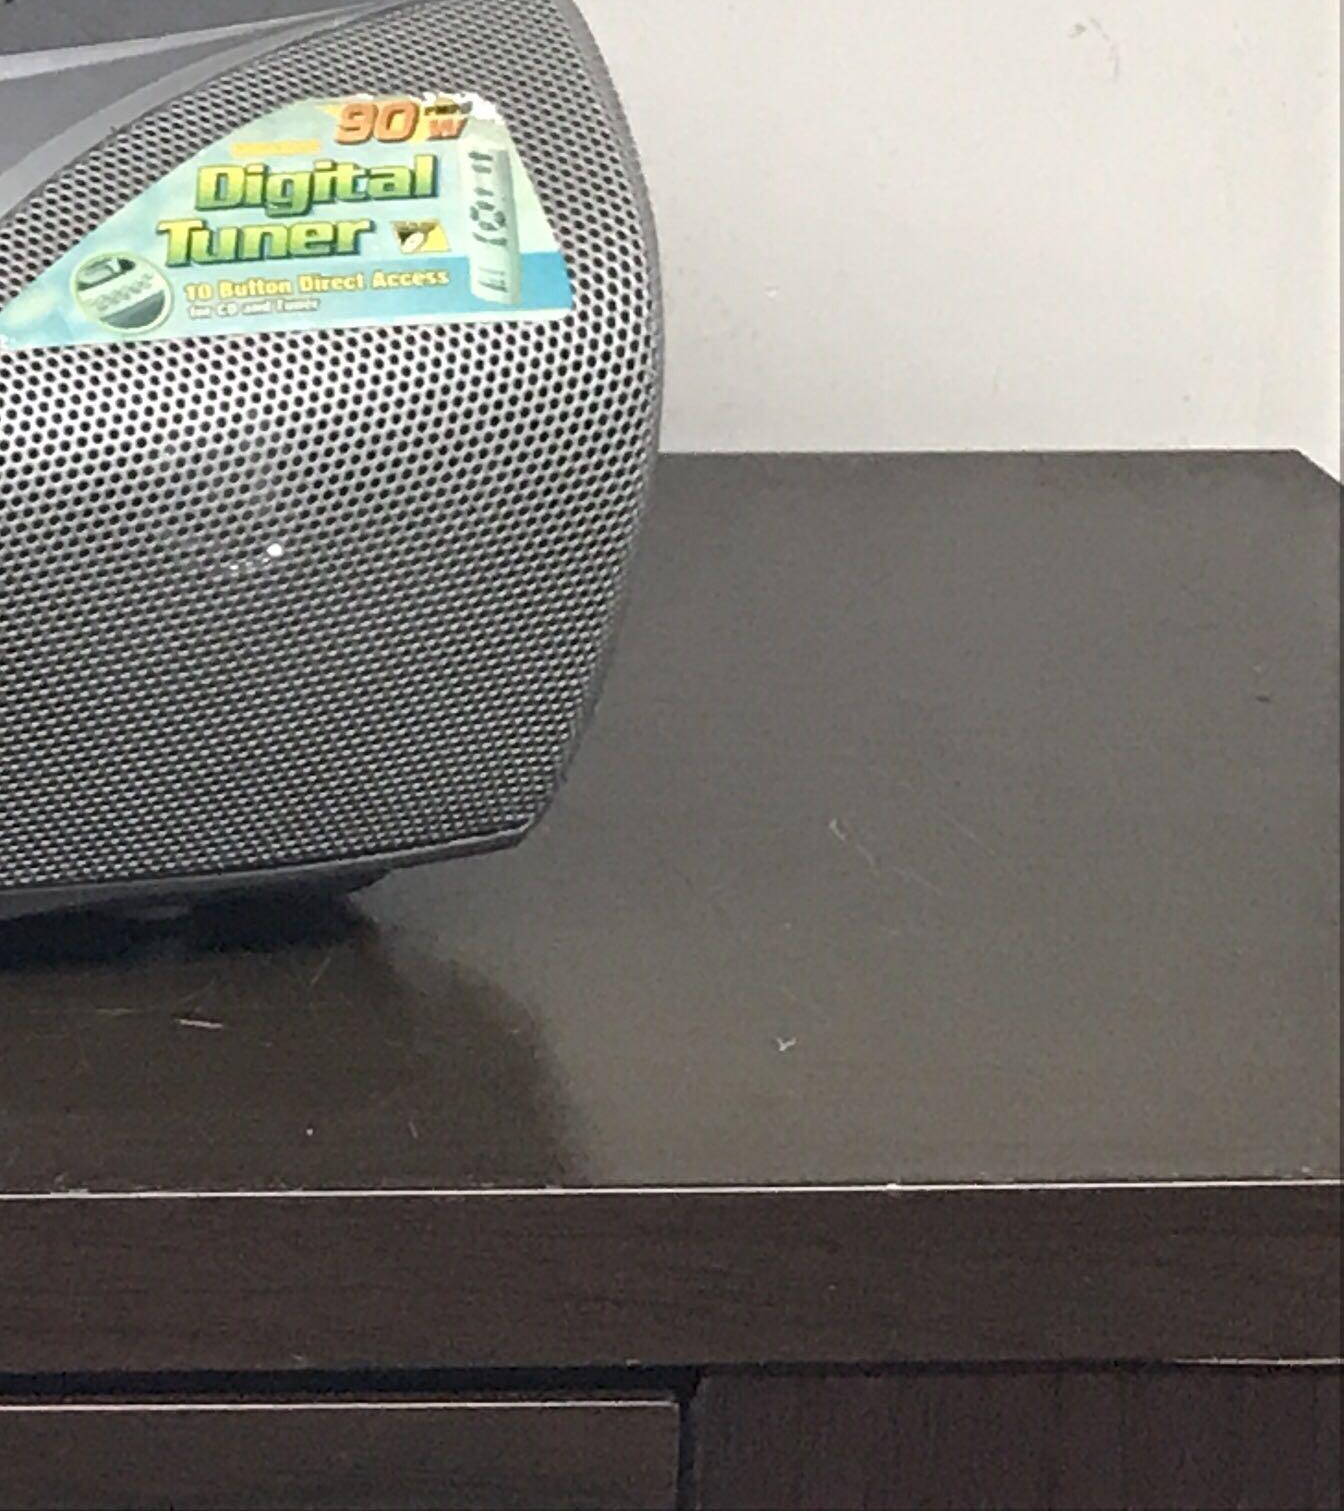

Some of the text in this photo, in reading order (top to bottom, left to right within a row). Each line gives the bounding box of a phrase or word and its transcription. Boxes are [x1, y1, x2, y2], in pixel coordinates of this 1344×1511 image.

[335, 101, 419, 145] 90
[195, 153, 439, 218] Digital
[156, 218, 376, 268] Tuner
[184, 269, 450, 302] 10 Button Direct Access
